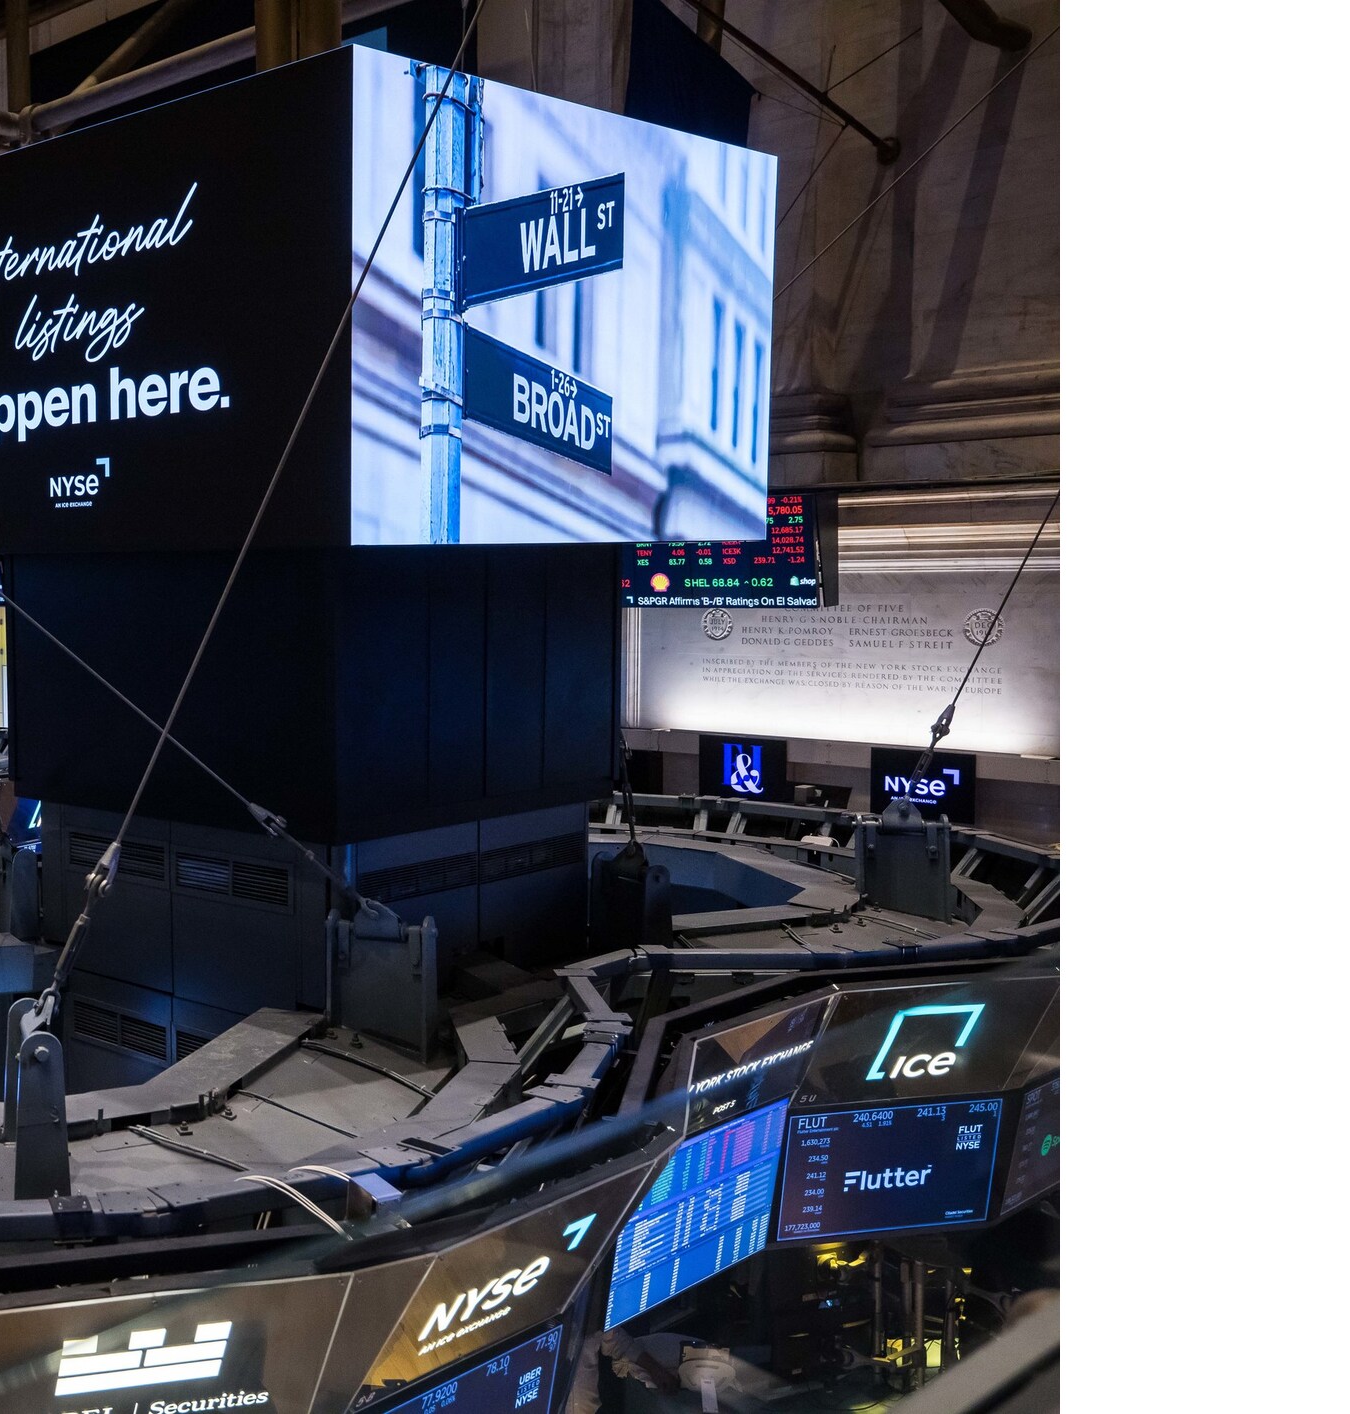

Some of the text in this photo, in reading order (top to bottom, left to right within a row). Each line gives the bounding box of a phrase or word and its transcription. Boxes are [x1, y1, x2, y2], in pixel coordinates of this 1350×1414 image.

[550, 187, 573, 215] 11-21
[520, 201, 615, 274] WALL ST
[14, 293, 145, 363] listings
[551, 369, 570, 397] 1-26
[109, 366, 230, 421] here.
[513, 372, 611, 451] BROAD ST
[768, 505, 803, 515] 5,780.05
[788, 516, 803, 524] 2.75
[787, 556, 805, 564] -1.24
[684, 579, 710, 588] SHEL
[712, 578, 740, 587] 68.84
[751, 578, 774, 587] 0.62
[637, 597, 668, 606] S&PGR
[725, 596, 759, 607] Ratings
[760, 596, 775, 606] On
[776, 596, 785, 606] El
[786, 596, 817, 606] Salvad
[857, 604, 904, 613] OF FIVE
[761, 615, 928, 625] HENRY NOBLE CHAIRMAN
[741, 626, 954, 637] HENRY POMROY ERNEST GROESBECK
[741, 637, 953, 650] DONALD GEDDES SAMUEL STREIT
[880, 663, 907, 671] YORK
[911, 664, 942, 673] STOCK
[947, 666, 1002, 674] EXCANGE
[965, 686, 1002, 696] EUROPE
[696, 1040, 815, 1094] YORK STOCK EXCHANGE
[712, 1102, 731, 1115] POST
[797, 1102, 999, 1130] FLUT 240.6400 241.13 245.00
[958, 1124, 983, 1134] FLUT
[800, 1137, 831, 1147] 1,630,273
[955, 1140, 980, 1151] NYSE
[808, 1154, 829, 1163] 234.50
[806, 1171, 827, 1180] 241.12
[843, 1165, 932, 1193] Flutter
[804, 1188, 825, 1197] 234.00
[802, 1204, 823, 1214] 239.14
[784, 1221, 821, 1232] 177,723,000
[535, 1330, 559, 1352] 77.90
[518, 1366, 542, 1385] UBER
[421, 1381, 458, 1410] 77.9200
[514, 1389, 539, 1409] NYSE
[148, 1390, 269, 1414] Securities
